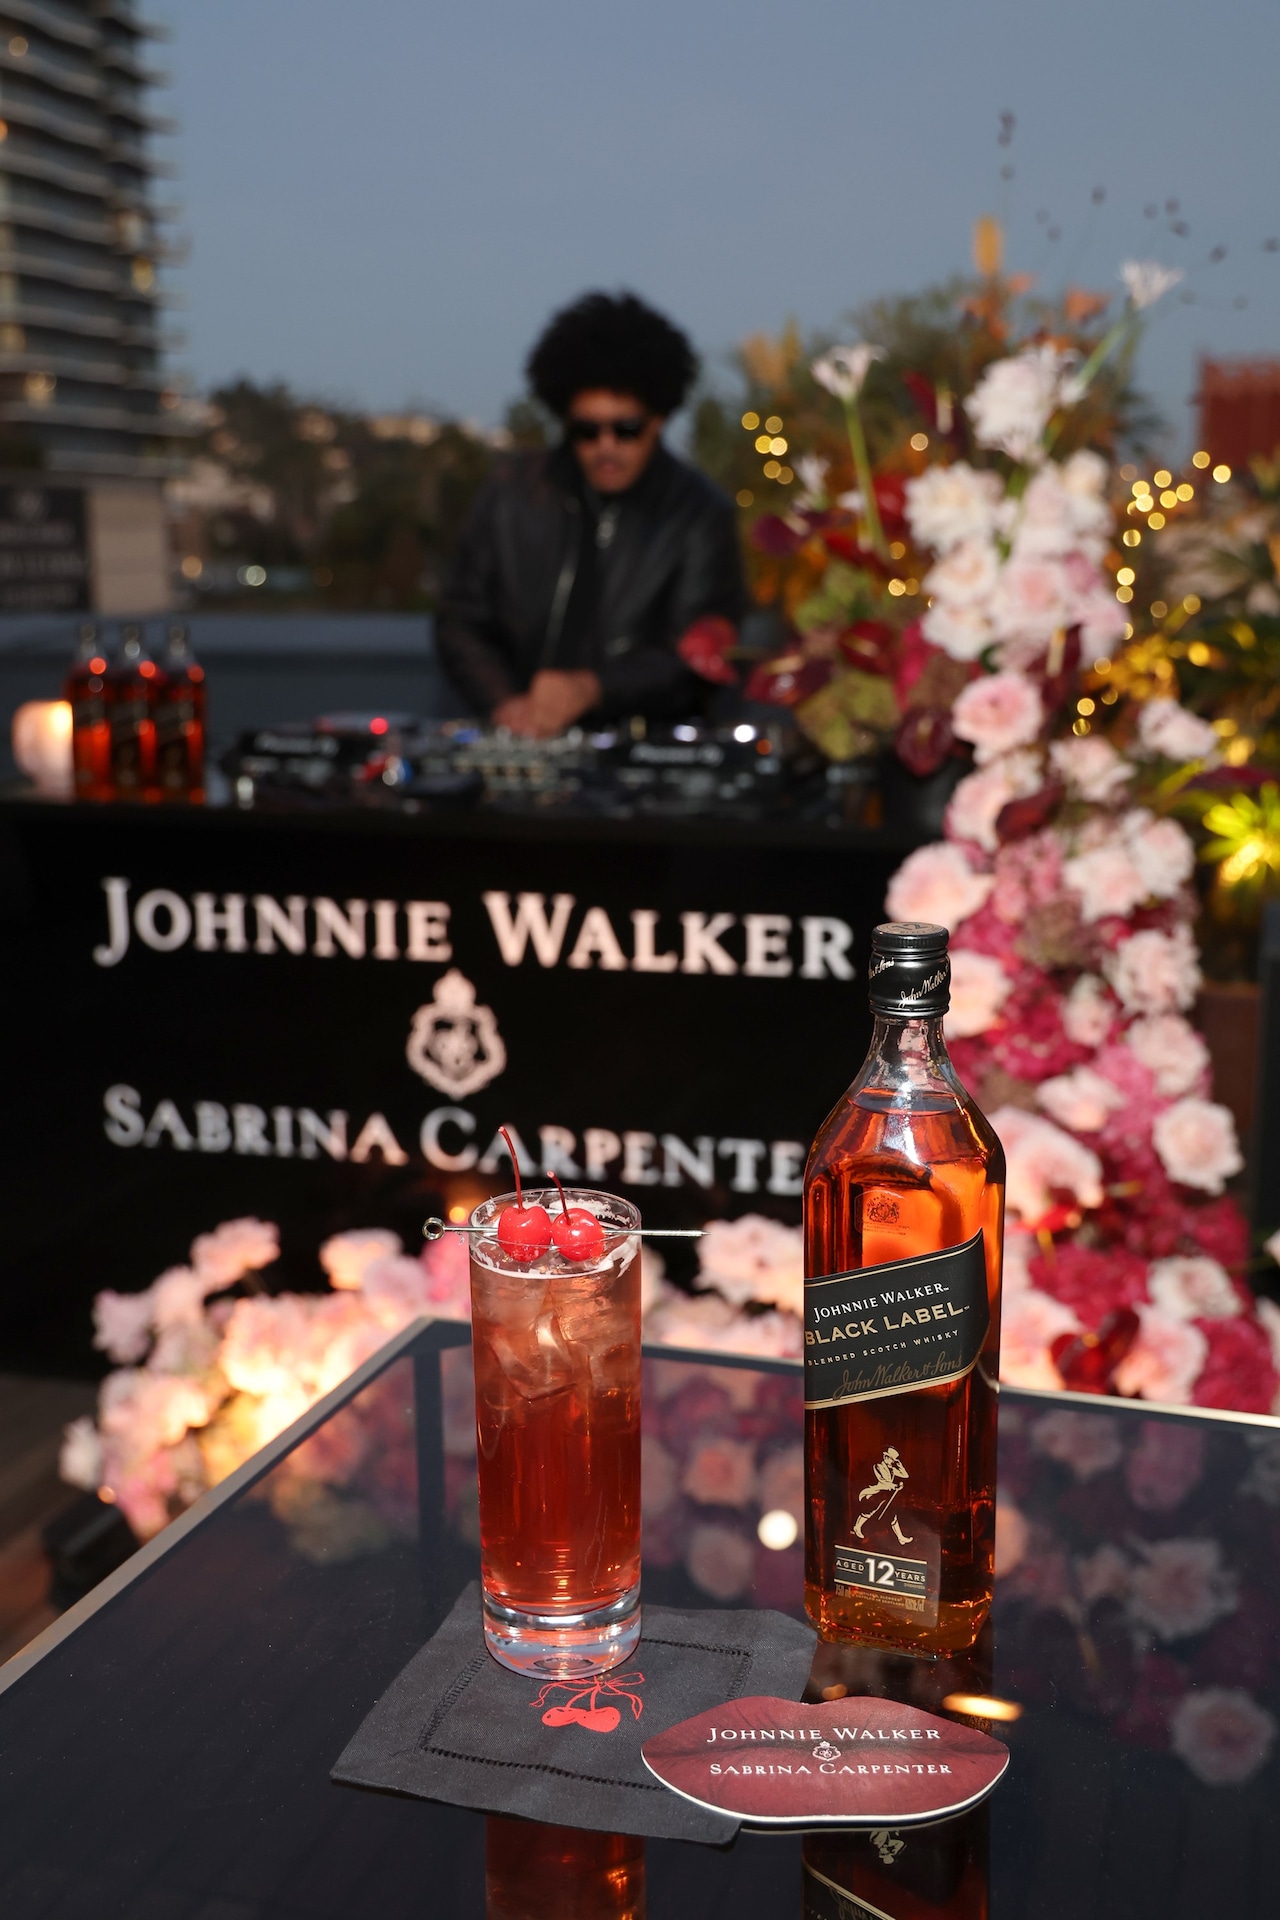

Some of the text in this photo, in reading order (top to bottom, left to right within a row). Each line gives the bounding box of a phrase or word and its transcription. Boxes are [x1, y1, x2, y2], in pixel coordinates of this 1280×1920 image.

[94, 876, 856, 981] JOHNNIE WALKER
[103, 1084, 804, 1196] SABRINA CARPENTE
[813, 1283, 944, 1323] JOHNNIE WALKER
[804, 1302, 964, 1346] BLACK LABEL
[808, 1329, 959, 1367] BLENDED SCOTCH WHISKY
[835, 1560, 865, 1572] AGED
[865, 1558, 895, 1587] 12
[895, 1570, 926, 1583] YEARS
[706, 1727, 941, 1743] JOHNNIE WALKER
[710, 1763, 952, 1775] SABRINA CARPENTER
